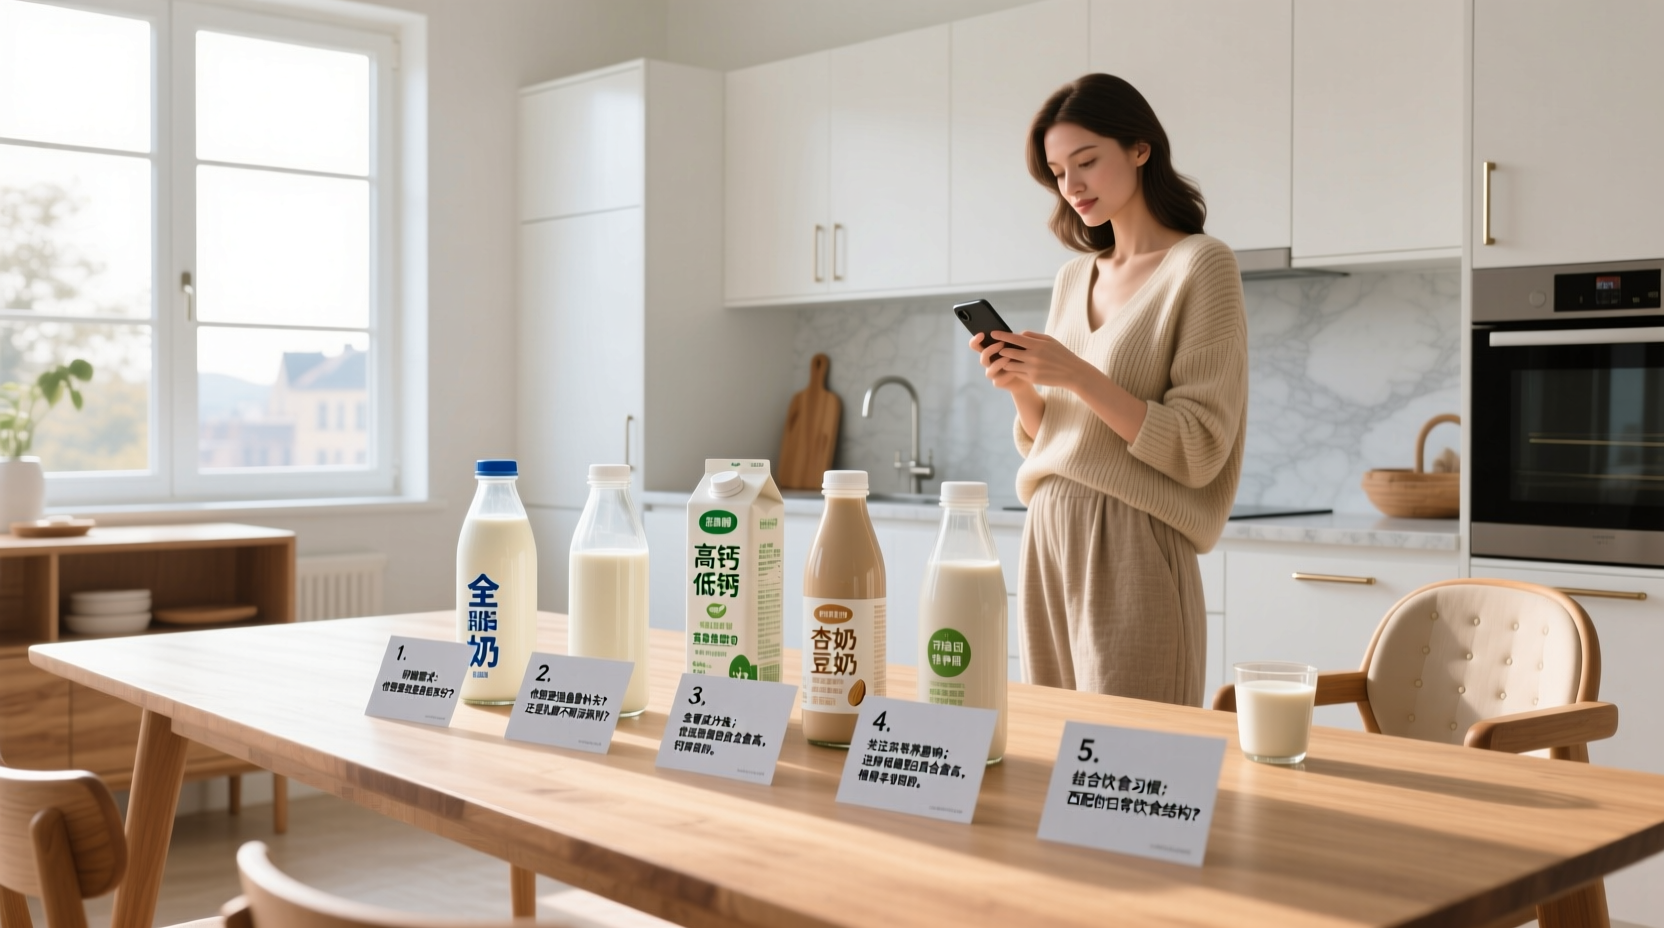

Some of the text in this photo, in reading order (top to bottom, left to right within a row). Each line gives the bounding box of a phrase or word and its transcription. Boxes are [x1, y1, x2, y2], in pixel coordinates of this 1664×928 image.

[694, 543, 741, 571] 高钙
[811, 626, 857, 650] 杏奶
[396, 644, 407, 661] 1.
[811, 651, 858, 676] 豆奶
[535, 664, 551, 683] 2.
[872, 710, 891, 733] 4.
[1077, 738, 1099, 764] 5.
